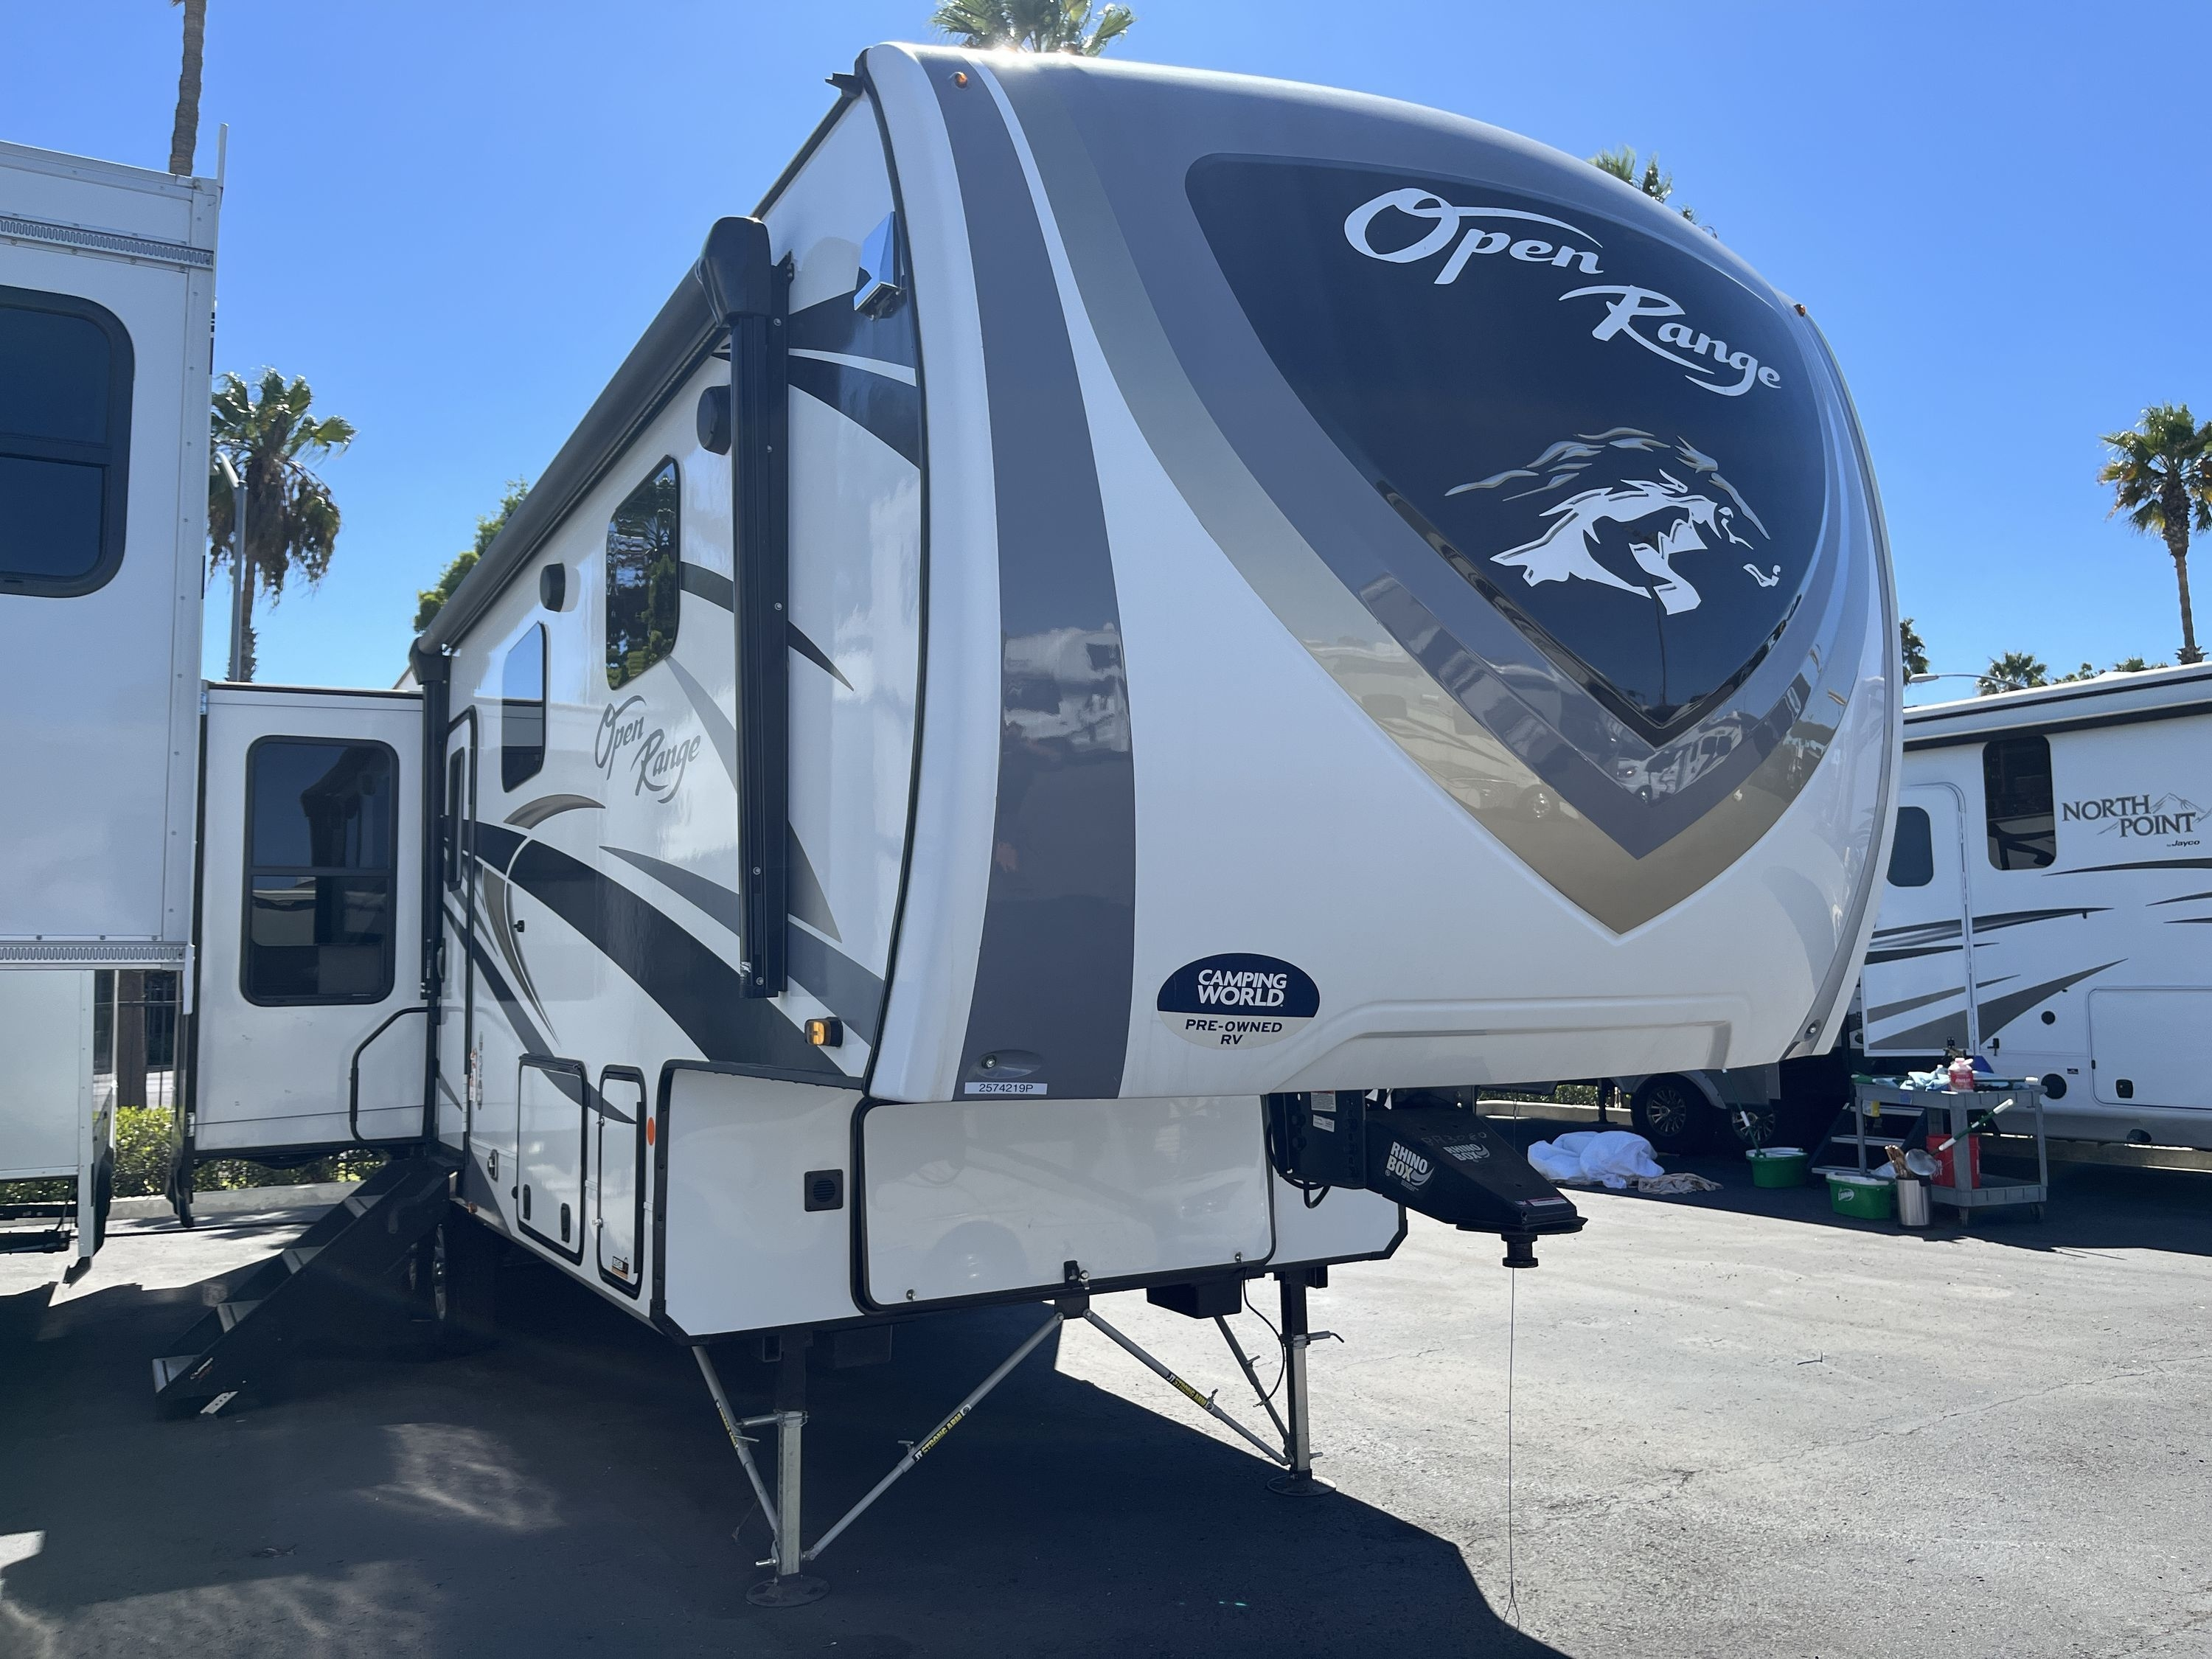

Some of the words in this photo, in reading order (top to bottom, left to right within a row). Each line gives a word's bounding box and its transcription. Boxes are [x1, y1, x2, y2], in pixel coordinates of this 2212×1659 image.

[1344, 187, 1604, 285] Open
[1558, 284, 1781, 397] Range
[594, 695, 647, 781] Open
[630, 728, 700, 804] Range
[2061, 794, 2152, 822] NORTH
[2119, 812, 2197, 838] POINT
[1198, 969, 1287, 989] CAMPING
[1197, 984, 1284, 1007] WORLD
[1185, 1018, 1283, 1033] PRE-OWNED
[1220, 1034, 1244, 1045] RV
[978, 1083, 1034, 1093] 2574219P
[1390, 1141, 1428, 1174] RHINO
[1442, 1144, 1481, 1154] RHINO
[1452, 1151, 1482, 1161] BOX
[1386, 1155, 1413, 1182] BOX
